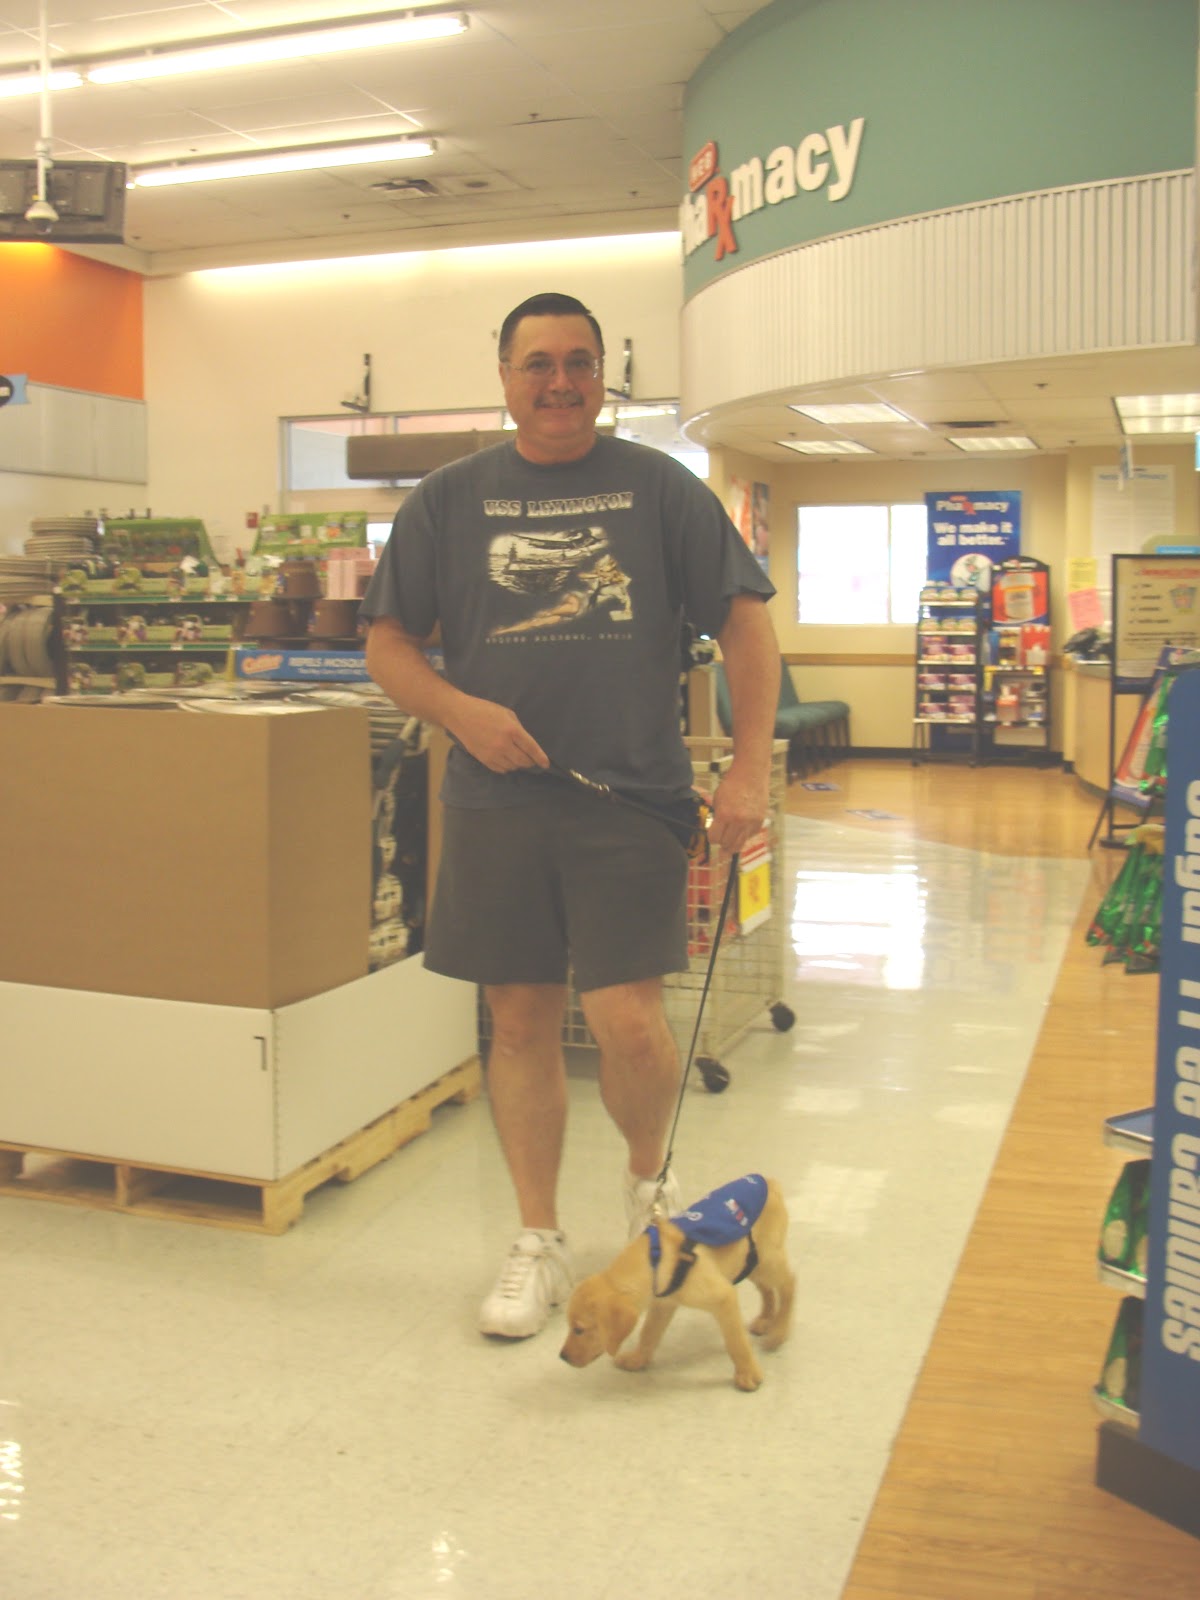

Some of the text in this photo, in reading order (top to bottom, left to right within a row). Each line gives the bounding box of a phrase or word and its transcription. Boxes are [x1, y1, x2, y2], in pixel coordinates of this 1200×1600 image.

[483, 491, 634, 518] USS LEXINGTON
[932, 521, 1014, 534] We make it
[937, 534, 957, 546] all
